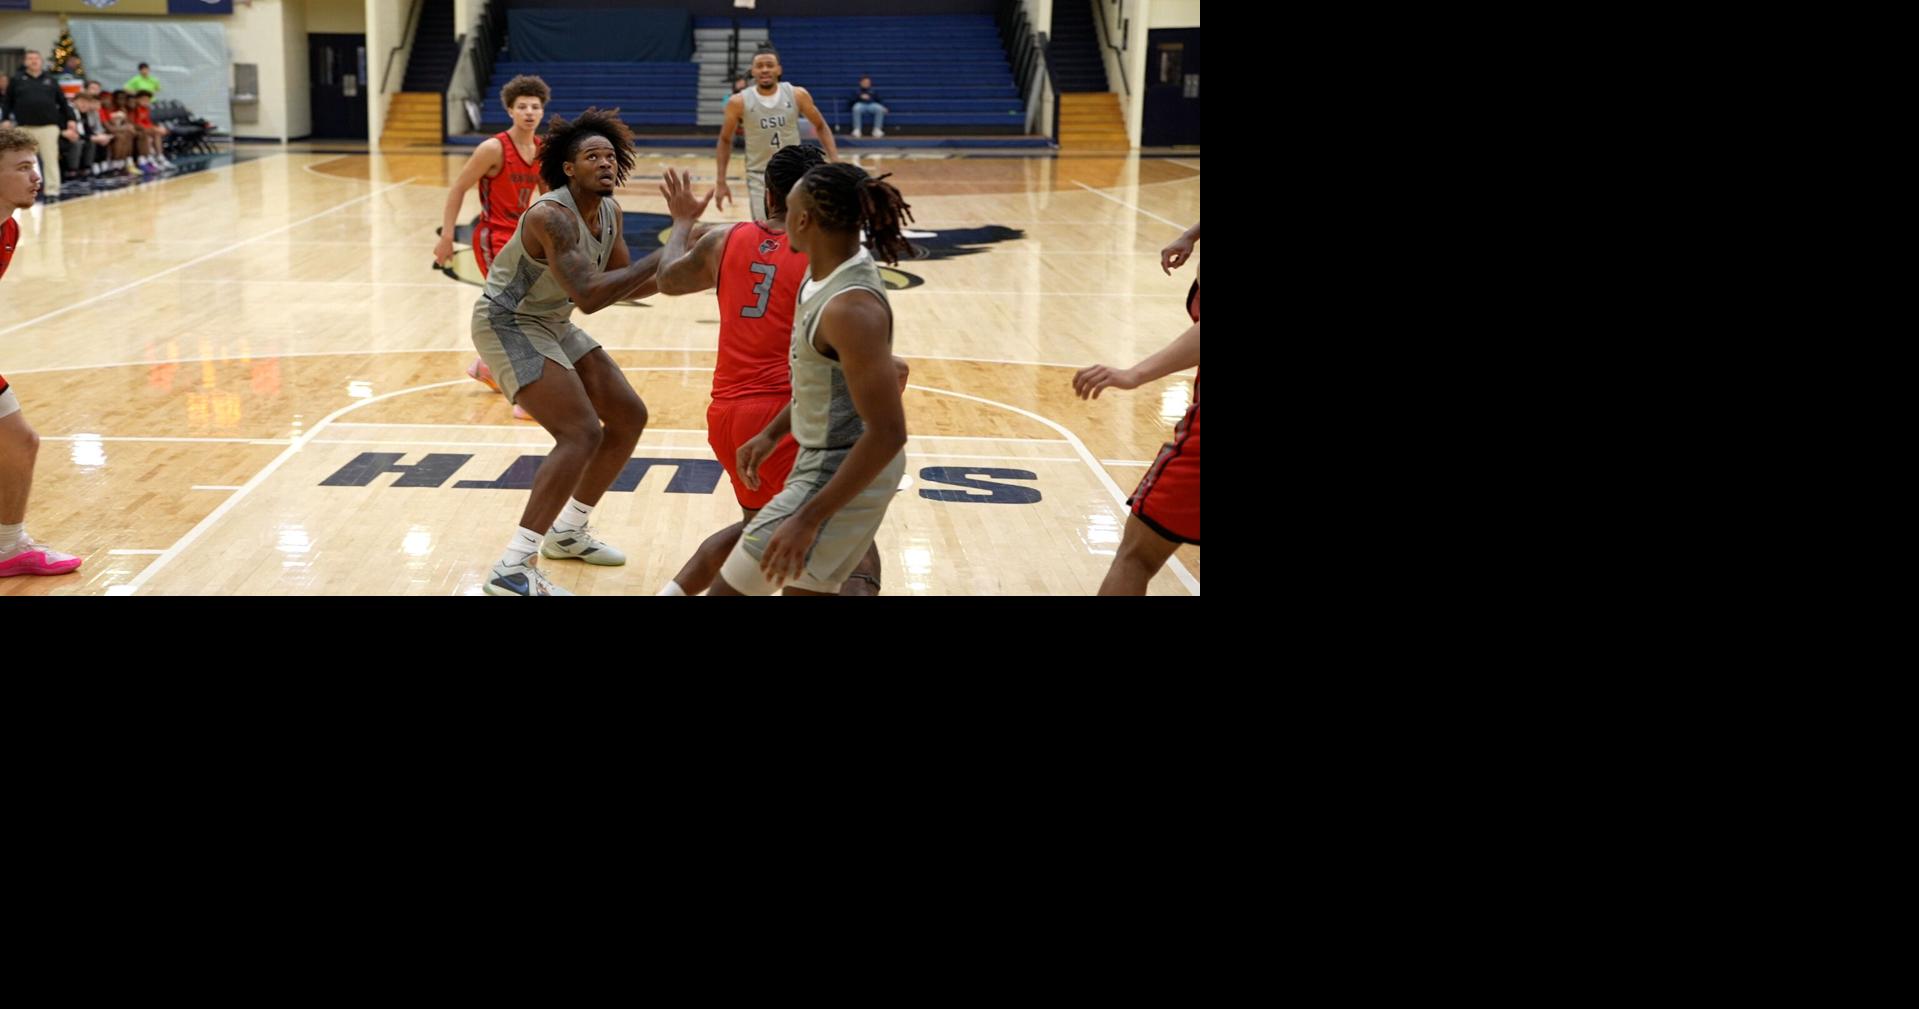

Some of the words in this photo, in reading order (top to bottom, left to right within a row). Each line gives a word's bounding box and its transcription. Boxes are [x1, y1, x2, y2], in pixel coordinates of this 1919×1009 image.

[760, 116, 785, 129] CSU
[770, 132, 780, 149] 4
[740, 261, 777, 318] 3
[318, 451, 1042, 505] SUTH
